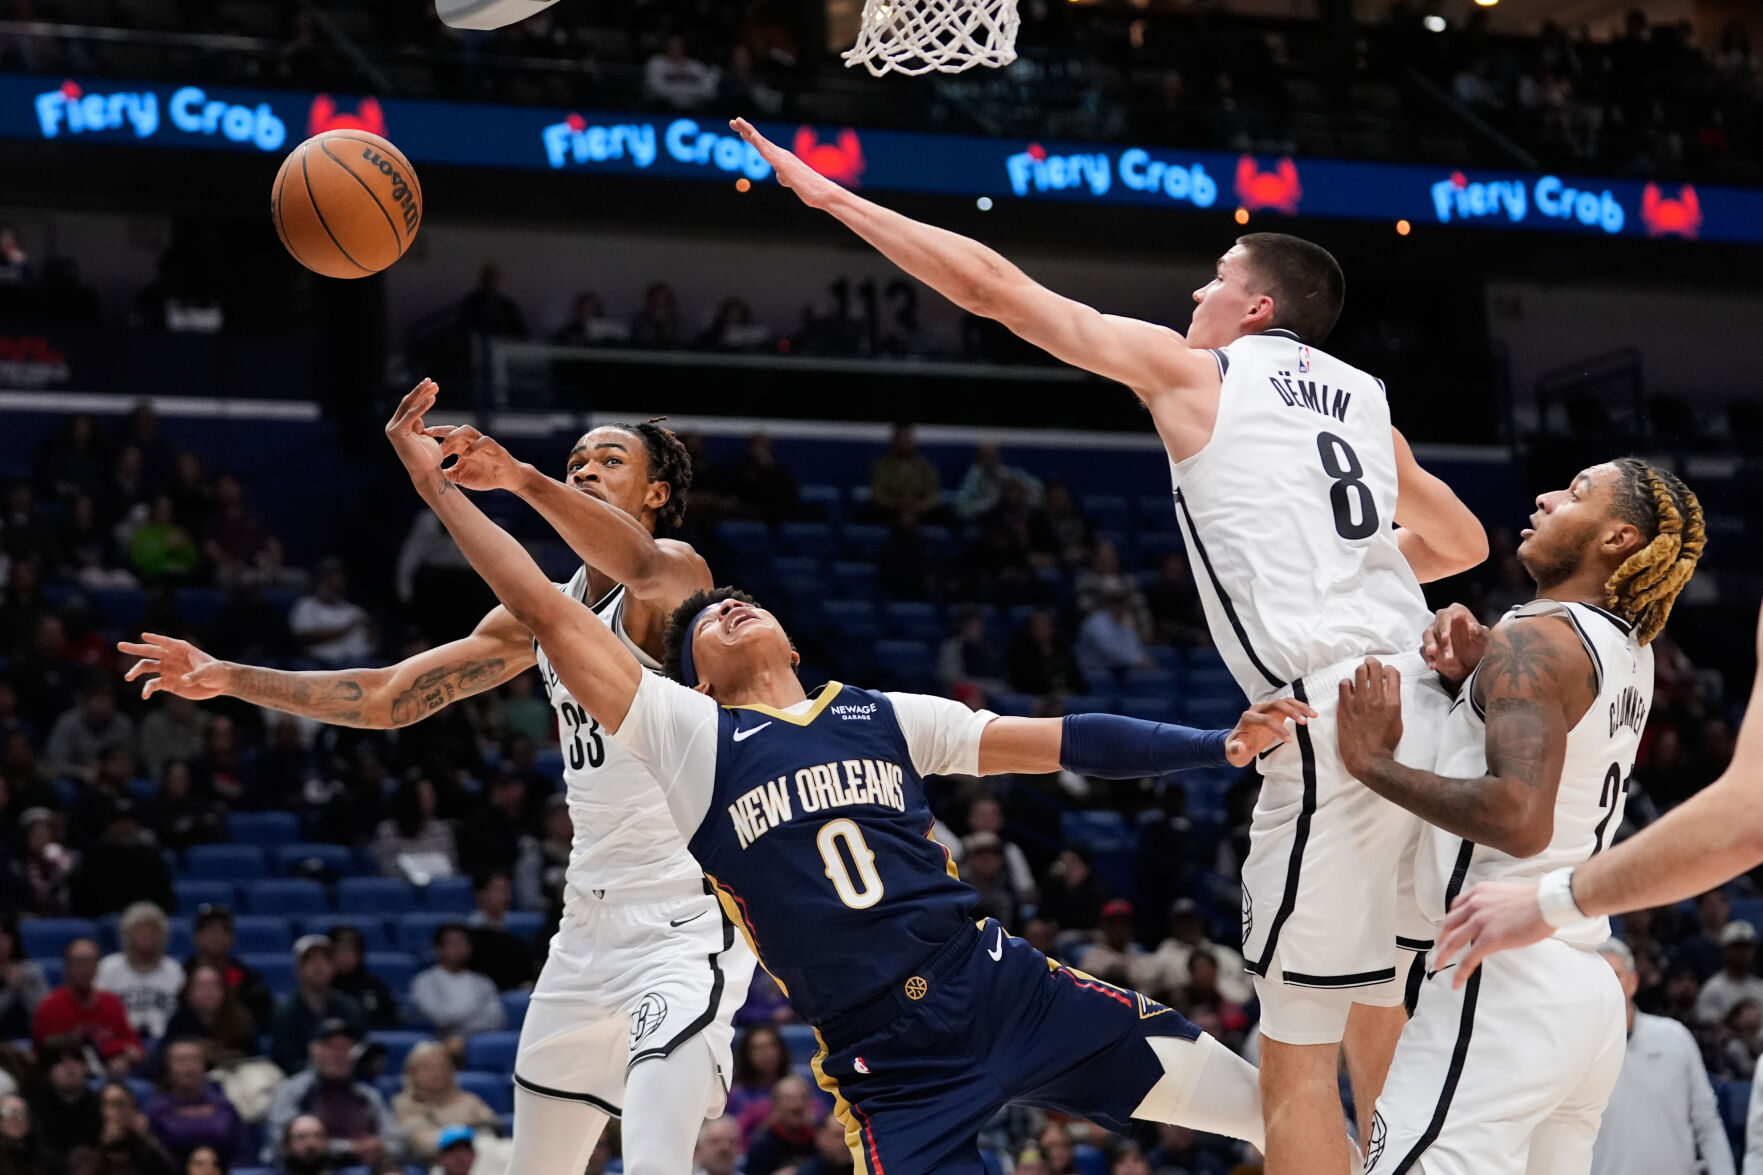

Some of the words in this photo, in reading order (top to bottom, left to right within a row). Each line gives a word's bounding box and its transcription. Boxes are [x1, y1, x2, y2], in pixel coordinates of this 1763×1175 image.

[35, 80, 159, 137] Fiery
[169, 87, 286, 151] Crab
[542, 113, 657, 168] Fiery
[362, 147, 419, 237] Wilson
[1006, 143, 1111, 196] Fiery
[1119, 148, 1217, 207] Crab
[1432, 171, 1528, 221] Fiery
[1534, 176, 1625, 233] Crab
[1269, 371, 1351, 423] DËMIN
[1316, 431, 1380, 540] 8
[561, 701, 605, 771] 33
[830, 702, 877, 715] NEWAGE
[728, 775, 793, 851] NEW
[794, 759, 906, 813] ORLEANS
[816, 817, 885, 910] 0
